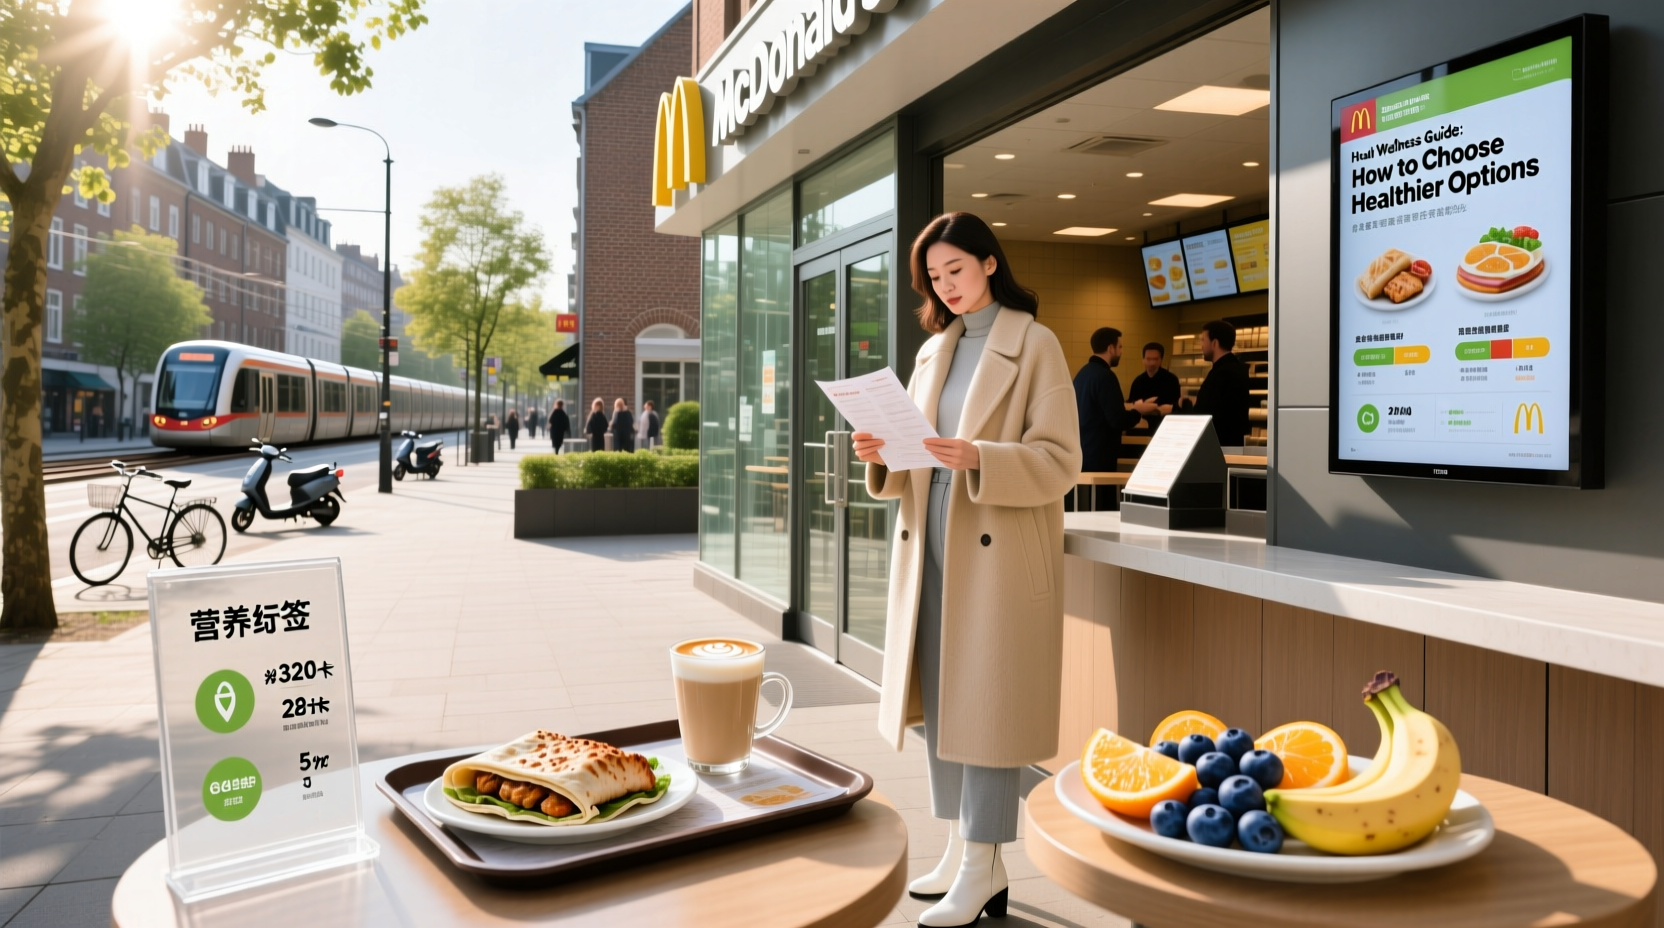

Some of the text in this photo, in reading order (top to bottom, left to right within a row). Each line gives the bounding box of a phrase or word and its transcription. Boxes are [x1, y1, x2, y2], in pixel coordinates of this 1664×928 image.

[1424, 124, 1464, 144] Guide:
[1351, 157, 1540, 215] Healthier Options
[1352, 136, 1505, 188] How to Choose
